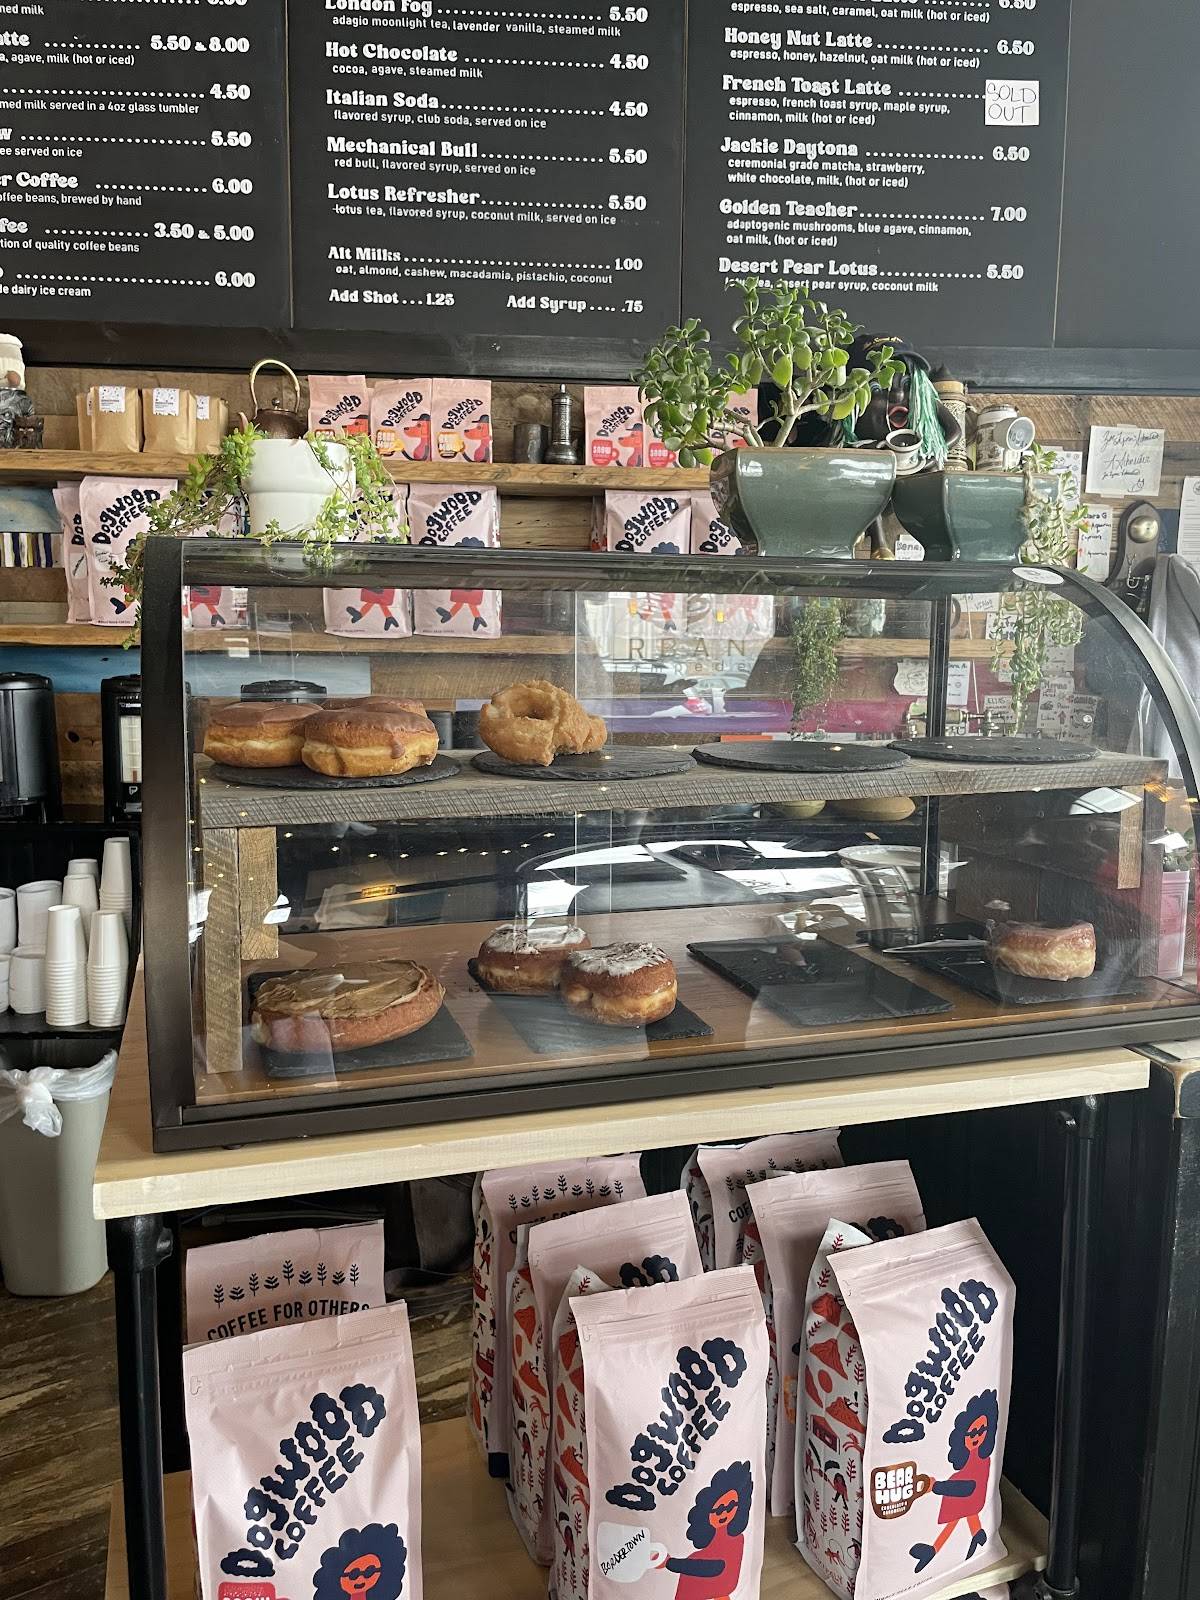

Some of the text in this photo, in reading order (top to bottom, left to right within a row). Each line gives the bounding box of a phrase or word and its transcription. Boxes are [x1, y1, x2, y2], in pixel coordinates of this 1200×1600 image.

[325, 0, 648, 22] London Fog 5.50
[731, 3, 990, 23] espresso, sea salt, caramel, oat milk (hot or iced)
[333, 15, 621, 36] adagio moonlight tea, lavender vanilla, steamed milk
[150, 35, 250, 52] 5.50 8.00
[725, 27, 1034, 55] Honey Nut Latte 6.50
[11, 53, 134, 66] agave, milk (hot or iced)
[326, 41, 649, 70] Hot Chocolate 4.50
[332, 65, 483, 78] cocoa, agave, steamed milk
[209, 83, 250, 100] 4.50
[723, 74, 891, 96] French Toast Latte
[987, 82, 1036, 103] SOLD
[24, 100, 47, 109] milk
[50, 101, 84, 110] served
[87, 101, 96, 110] in
[108, 101, 125, 111] 4oz
[128, 102, 156, 113] glass
[159, 103, 199, 113] tumbler
[326, 89, 648, 117] Italian Soda 4.50
[729, 97, 950, 114] espresso, french toast syrup, maple syrup,
[988, 104, 1030, 124] OUT
[211, 131, 251, 147] 5.50
[720, 137, 1030, 161] Jackie Daytona 6.50
[327, 136, 647, 164] Mechanical Bull 5.50
[728, 158, 925, 175] ceremonial grade matcha, strawberry,
[16, 172, 253, 194] Coffee 6.00
[25, 192, 142, 206] beans, brewed by hand
[328, 183, 646, 210] Lotus Refresher 5.50
[366, 206, 616, 225] tea, flavored syrup, coconut milk, served on ice
[719, 198, 1027, 221] Golden Teacher 7.00
[154, 222, 254, 241] 3.50 5.00
[727, 219, 971, 236] adaptogenic mushrooms, blue agave, cinnamon,
[22, 239, 139, 252] of quality coffee beans
[328, 246, 643, 270] Alt Milks 1.00
[719, 257, 1024, 279] Desert Pear Lotus 5.50
[215, 271, 255, 288] 6.00
[336, 265, 612, 283] oat, almond, cashew, macadamia, pistachio, coconut
[11, 284, 91, 296] dairy ice cream
[329, 289, 455, 306] Add Shot 1.25
[507, 295, 643, 313] Add Syrup .75
[438, 504, 472, 542] COFFEE
[635, 511, 670, 546] COFFEE
[274, 1302, 303, 1322] FOR
[926, 1322, 986, 1425] COFFEE
[656, 1385, 731, 1496] COFFEE
[874, 1466, 914, 1490] BEAR
[274, 1436, 364, 1560] COFFEE
[875, 1484, 914, 1504] HUG
